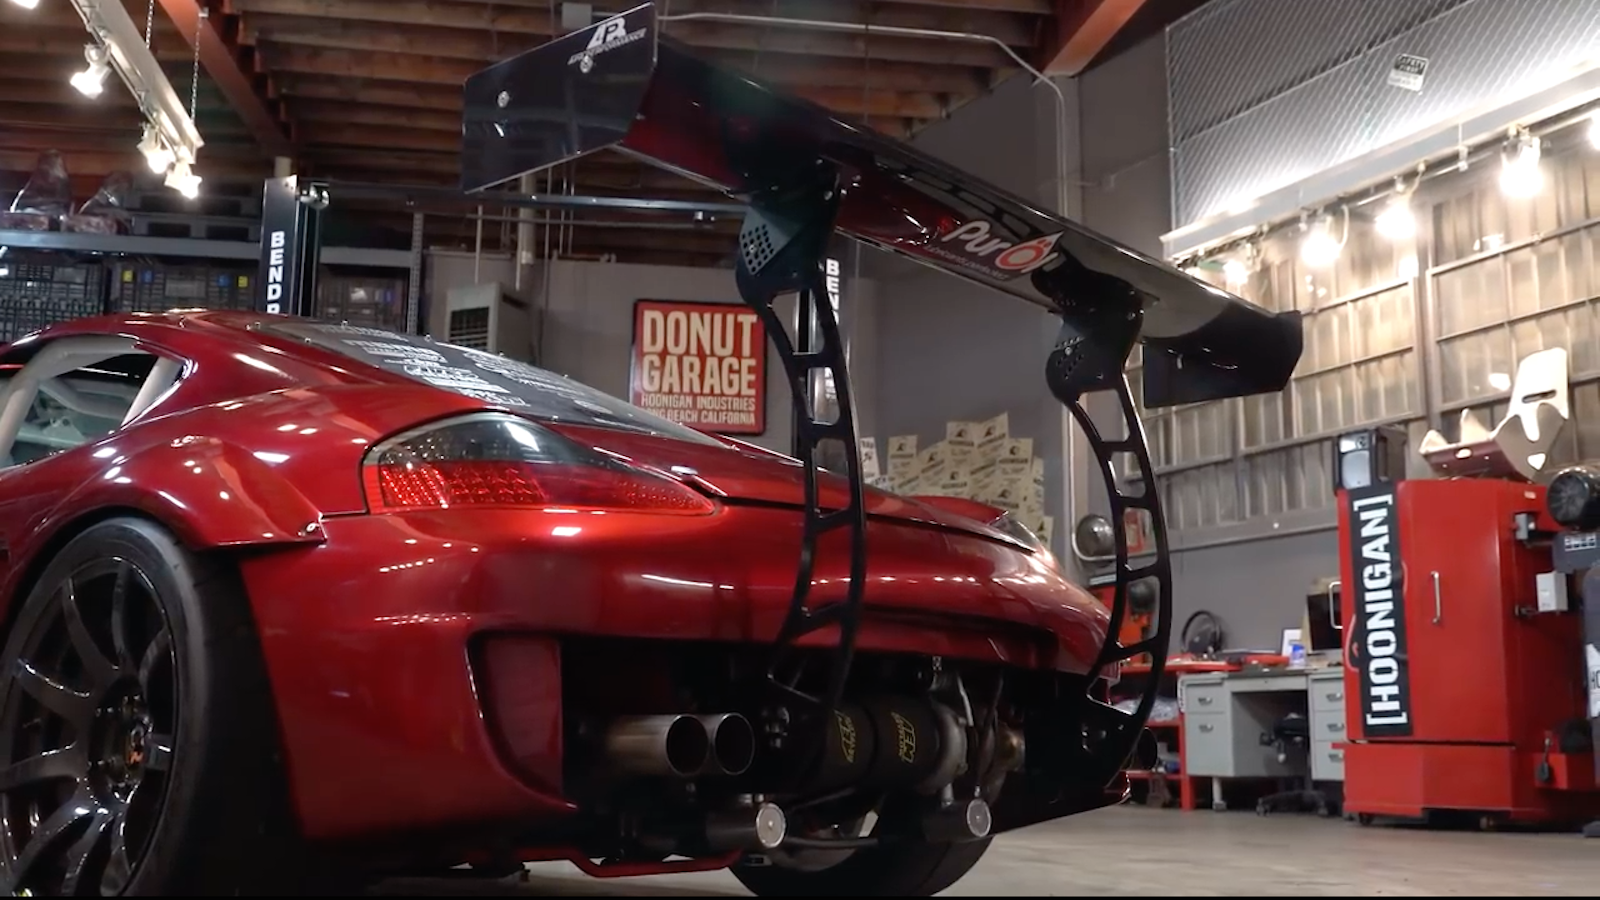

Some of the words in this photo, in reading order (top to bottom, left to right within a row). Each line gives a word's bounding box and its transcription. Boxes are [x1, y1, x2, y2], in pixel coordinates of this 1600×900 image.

[643, 309, 758, 357] DONUT
[641, 354, 756, 396] GARAGE
[640, 393, 693, 408] HOONIGAN
[696, 395, 756, 412] INDUSTRIES
[645, 407, 667, 419] ONG
[667, 408, 699, 423] BEACH
[701, 411, 756, 426] CALIFORNIA
